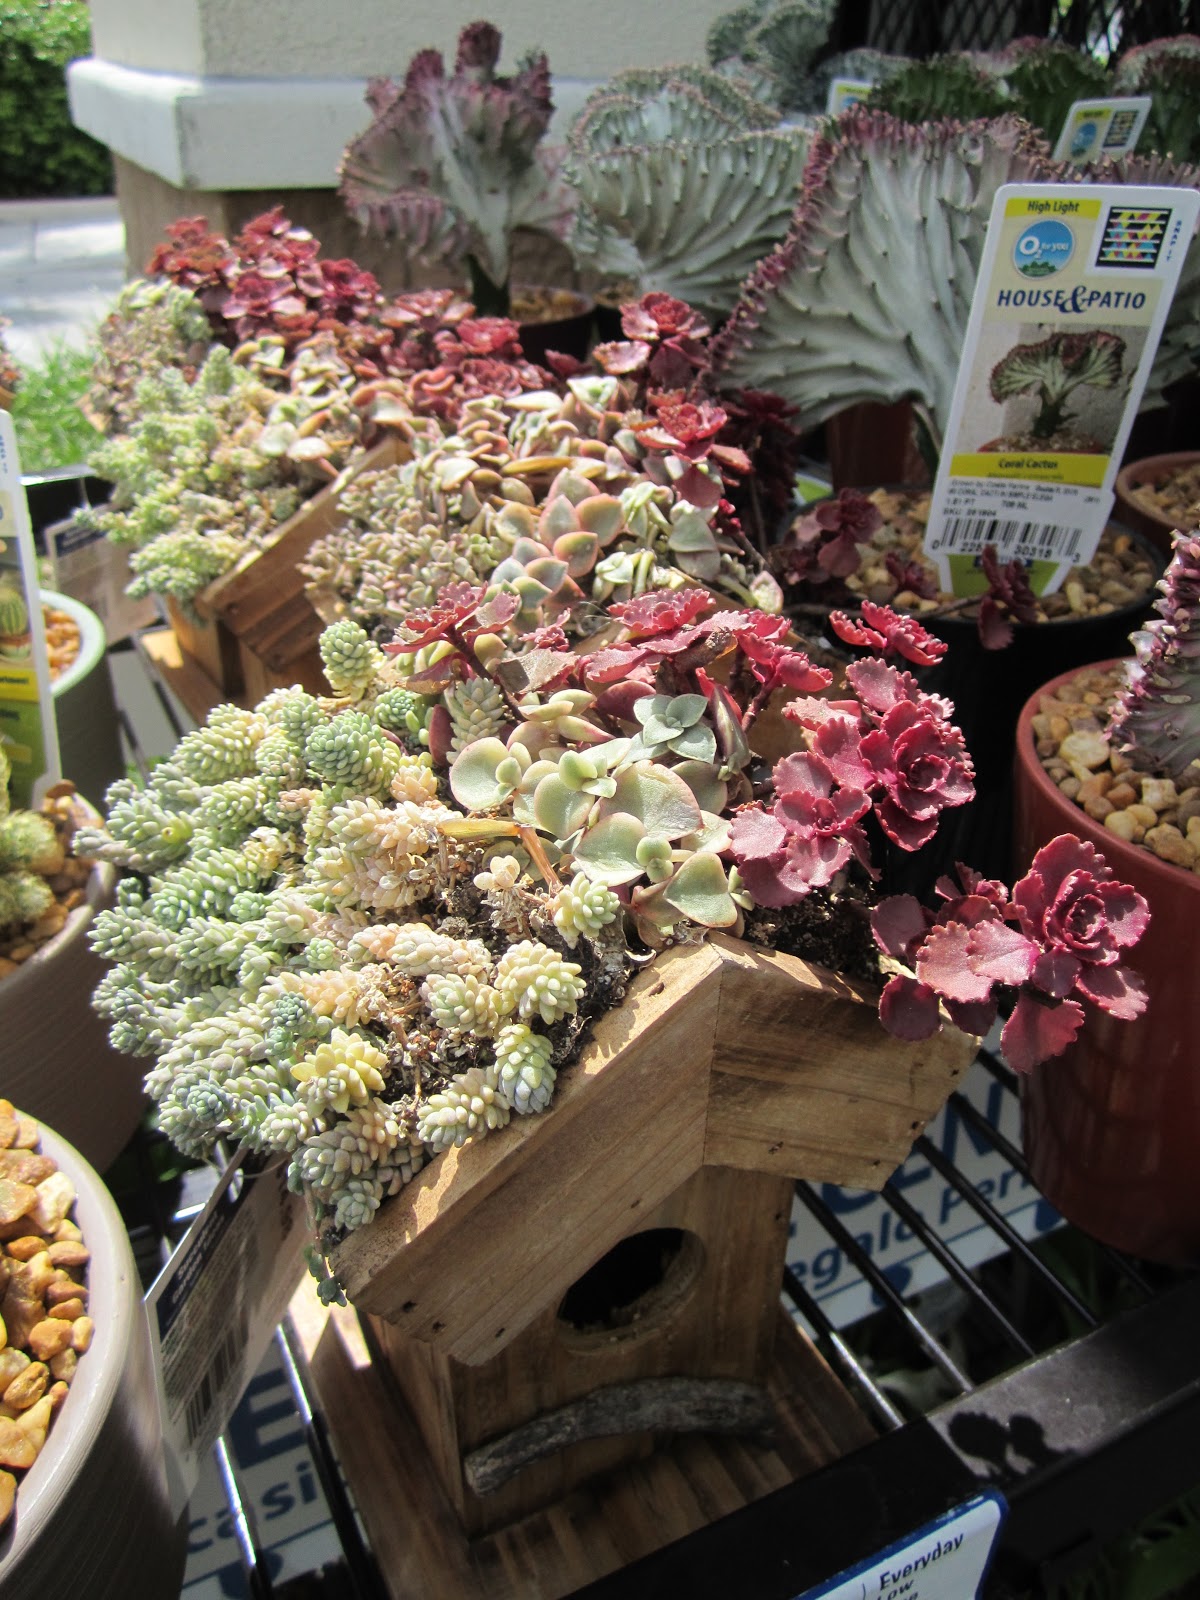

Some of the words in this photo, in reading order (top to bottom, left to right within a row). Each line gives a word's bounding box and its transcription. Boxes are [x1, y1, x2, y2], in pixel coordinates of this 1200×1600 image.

[1027, 200, 1051, 214] High
[1053, 202, 1080, 215] Light
[998, 459, 1024, 469] Coral
[1026, 459, 1058, 469] Cactus
[879, 1533, 964, 1591] Everyday
